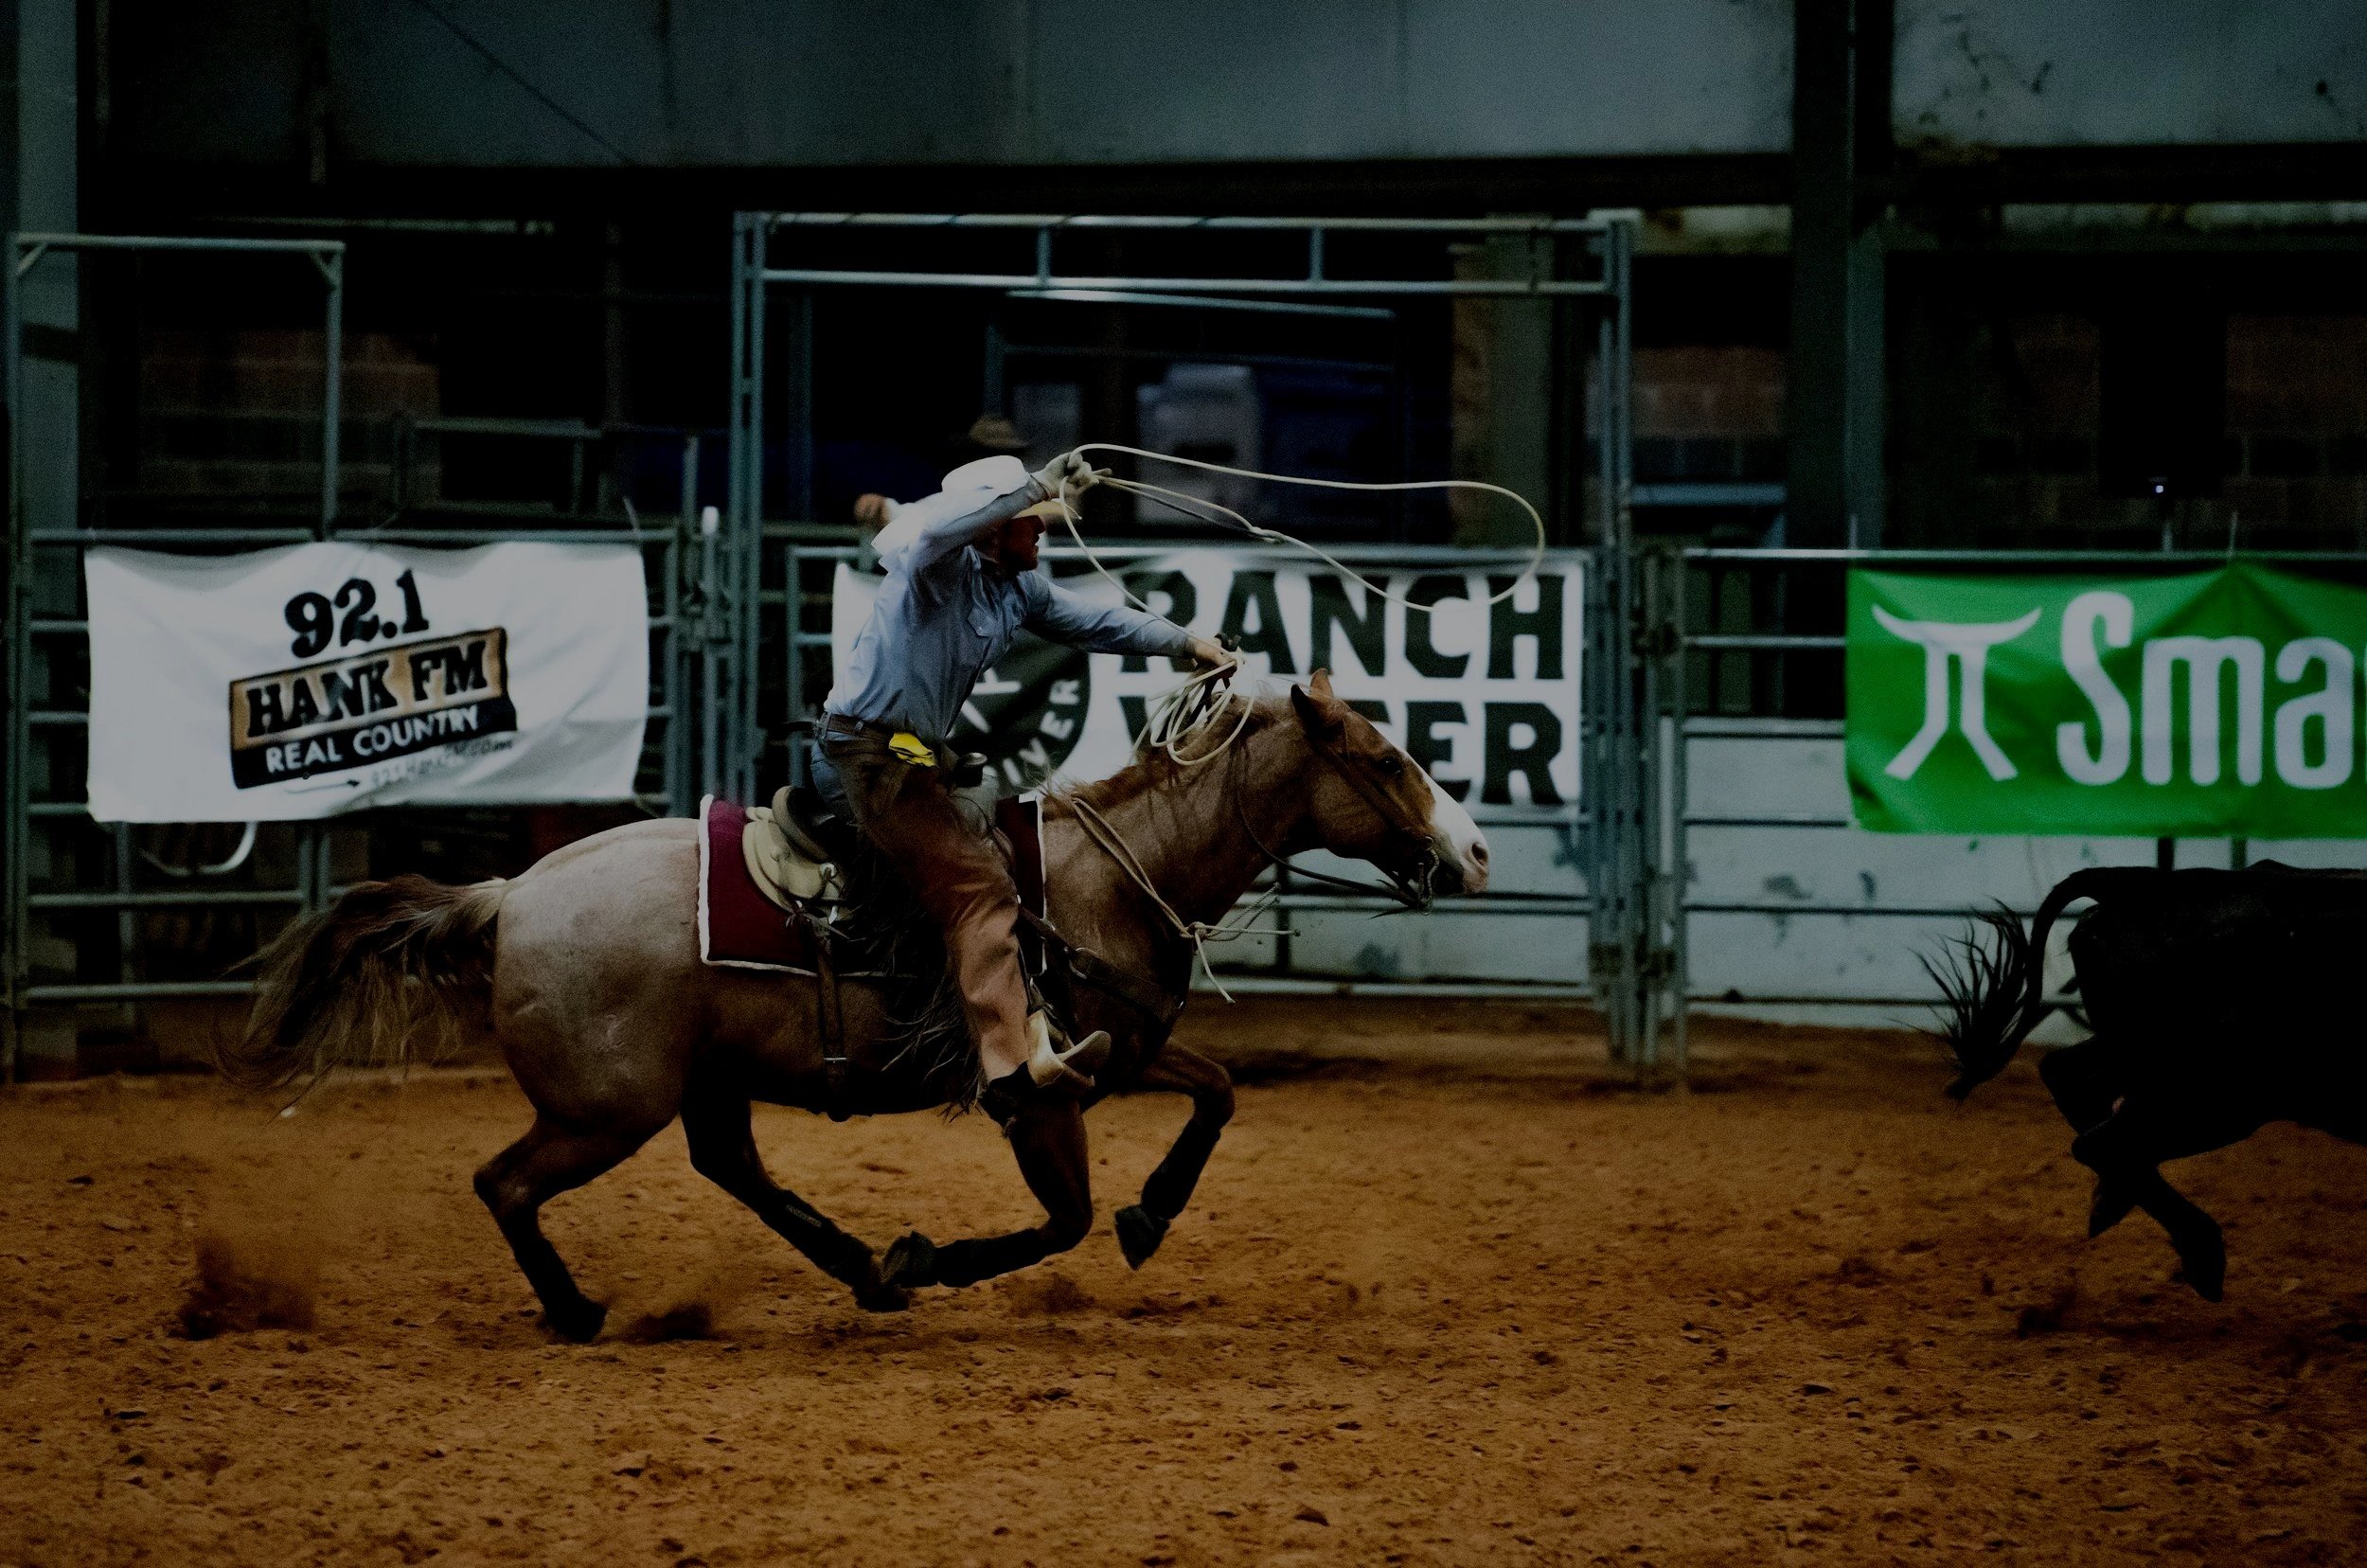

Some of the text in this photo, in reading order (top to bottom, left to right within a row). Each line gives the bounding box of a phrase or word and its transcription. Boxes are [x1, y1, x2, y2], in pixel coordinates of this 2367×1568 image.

[285, 569, 429, 657] 92.1
[1122, 570, 1564, 679] RANCH
[247, 642, 487, 737] HANK FM
[265, 739, 345, 773] REAL
[352, 705, 480, 757] COUNTRY
[982, 679, 1080, 788] IVER
[2056, 591, 2367, 789] Sma
